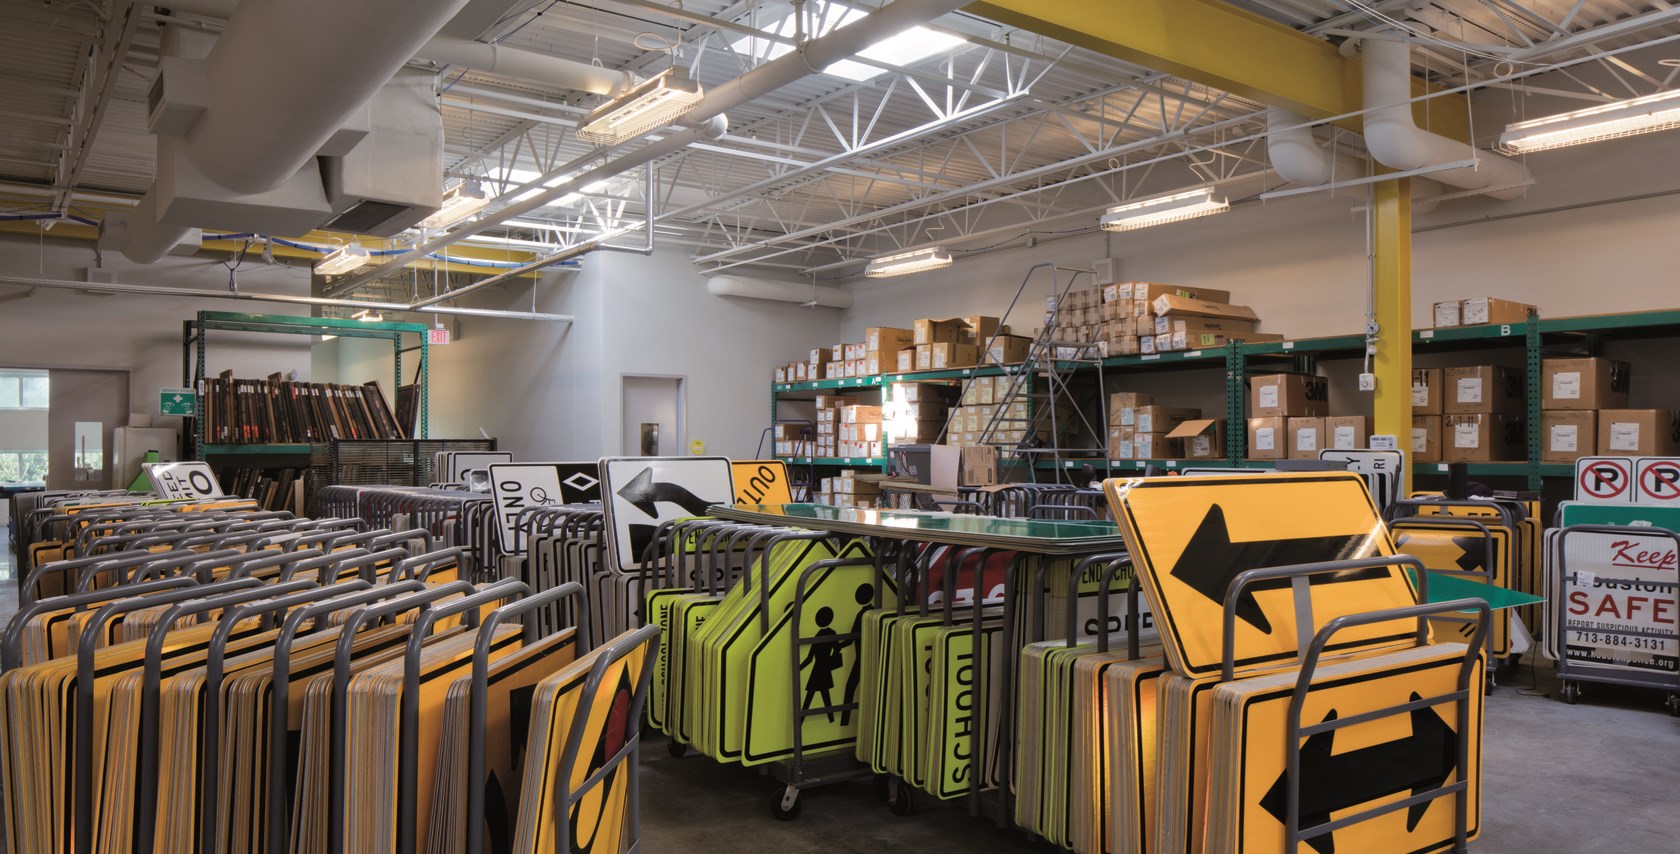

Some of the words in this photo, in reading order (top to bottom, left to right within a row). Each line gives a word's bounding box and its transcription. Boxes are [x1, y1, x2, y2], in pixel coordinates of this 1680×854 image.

[431, 331, 447, 343] EXIT
[1501, 325, 1511, 336] B
[1305, 381, 1327, 402] 3M
[1611, 540, 1677, 570] Keep
[1082, 562, 1102, 584] END
[1568, 591, 1675, 624] SAFE
[1567, 619, 1594, 630] REPORT
[1576, 631, 1665, 651] 713-884-3131
[952, 653, 974, 785] SCHOOL
